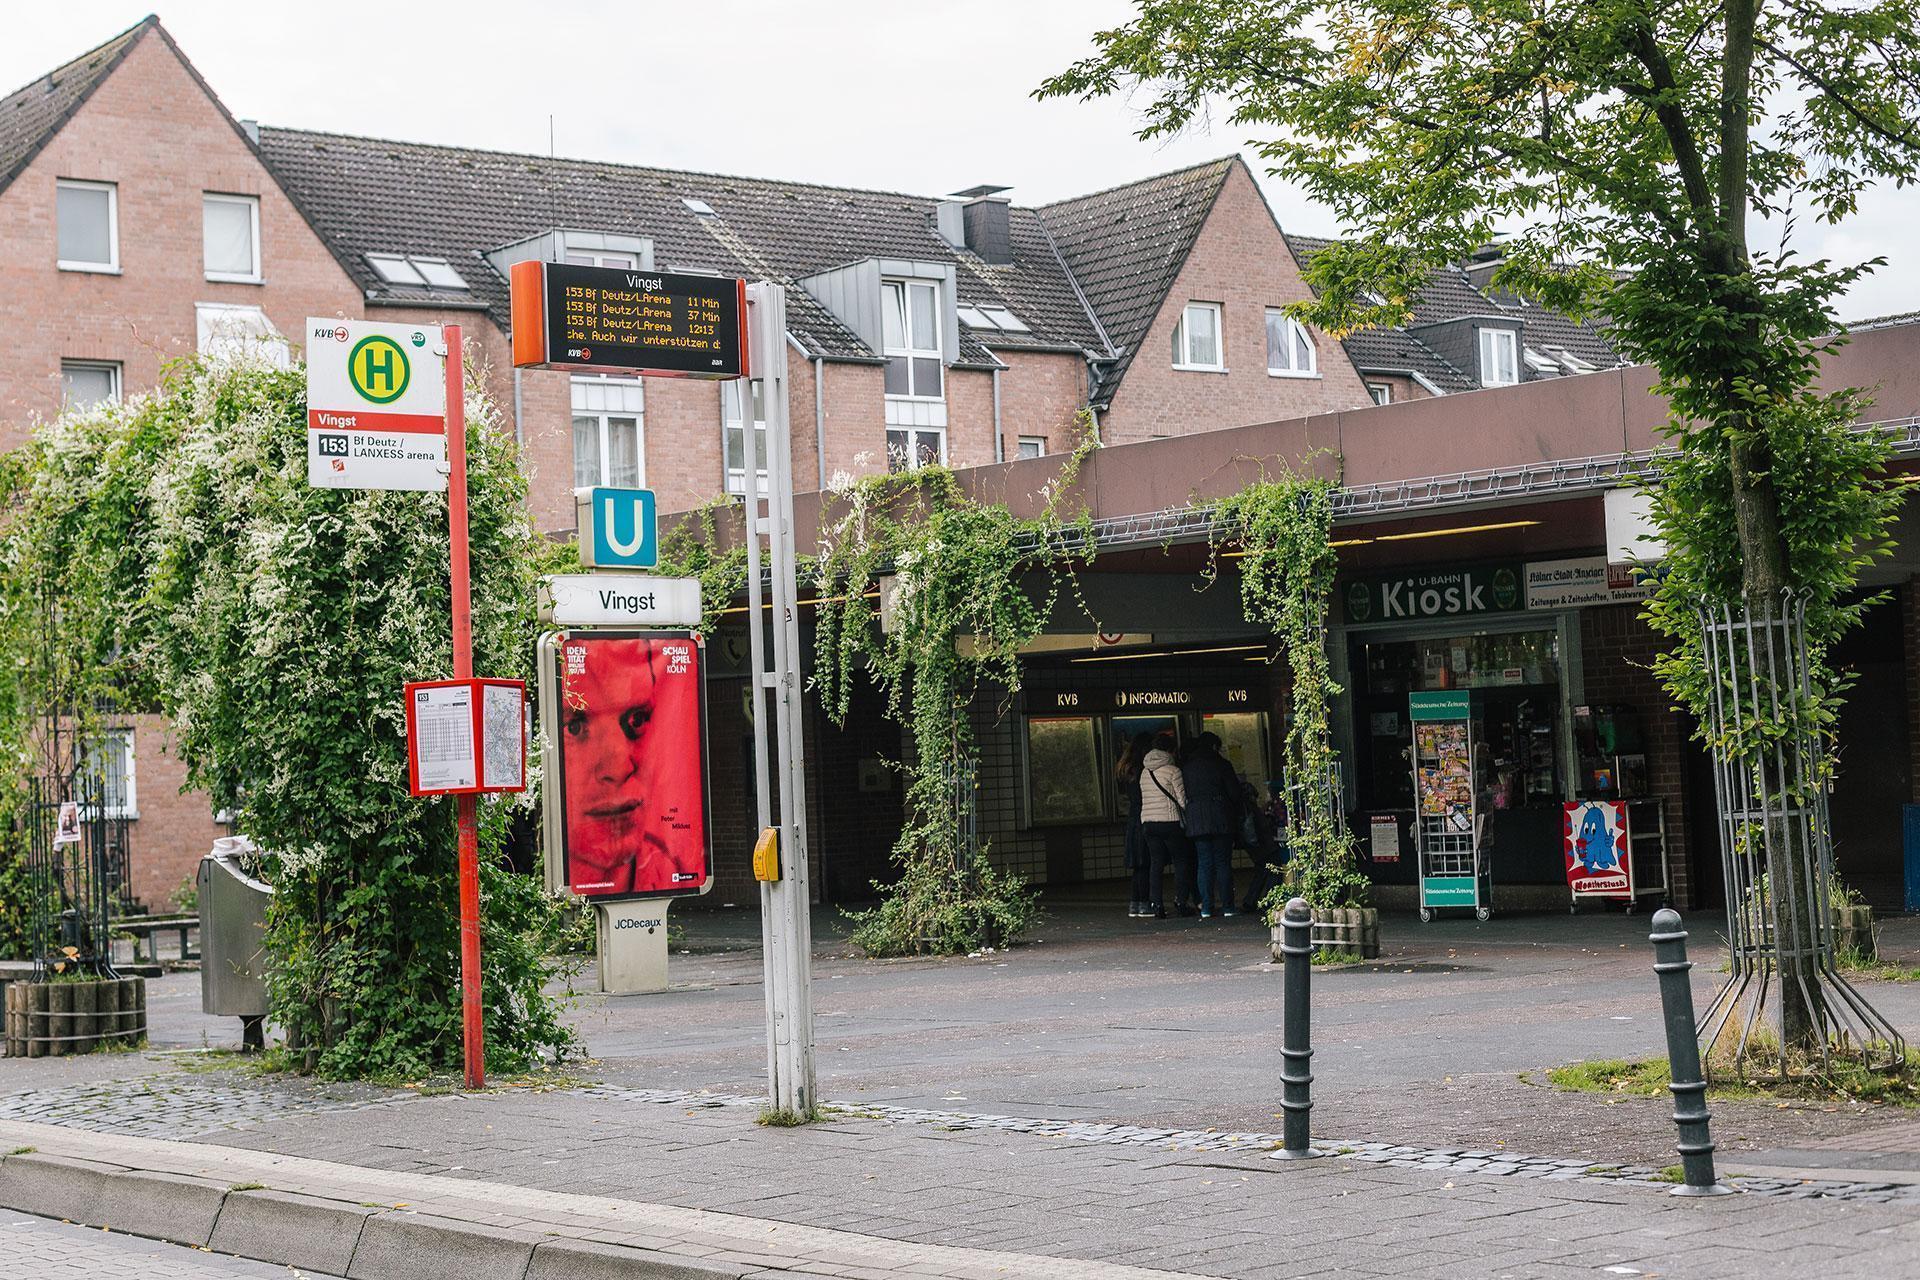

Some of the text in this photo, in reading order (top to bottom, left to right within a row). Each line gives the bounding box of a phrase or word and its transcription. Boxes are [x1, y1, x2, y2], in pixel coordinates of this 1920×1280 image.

[626, 274, 663, 291] Vingst
[565, 287, 584, 298] 153
[586, 288, 596, 300] Bf
[688, 297, 699, 307] 11
[702, 298, 720, 309] Min
[566, 301, 584, 312] 153
[586, 302, 597, 314] Bf
[687, 311, 699, 321] 37
[702, 312, 720, 322] Min
[566, 315, 584, 326] 153
[587, 316, 597, 328] Bf
[689, 325, 714, 335] 12:13
[314, 329, 334, 338] KVB
[411, 333, 422, 341] VRS
[592, 331, 617, 343] Auch
[621, 333, 638, 344] wir
[643, 335, 708, 349] unterstützen
[567, 349, 582, 358] KVB
[366, 349, 394, 391] H
[317, 413, 357, 428] Vingst
[320, 437, 347, 453] 153
[353, 436, 405, 448] Bf Deutz /
[354, 448, 435, 461] LANXESS arena
[605, 498, 644, 557] U
[1419, 574, 1461, 586] U-BAHN
[599, 590, 656, 613] Vingst
[1381, 573, 1486, 618] Kiosk
[1530, 595, 1560, 607] Zeitungen
[1561, 595, 1567, 604] &
[662, 646, 688, 656] SCHAU
[671, 656, 691, 665] SPIEL
[667, 663, 687, 674] KÖLN
[1057, 693, 1078, 706] KVB
[1228, 689, 1248, 702] KVB
[1447, 700, 1469, 709] Zeitung
[1456, 886, 1475, 895] Zeitung
[615, 918, 662, 930] JCDecaux
